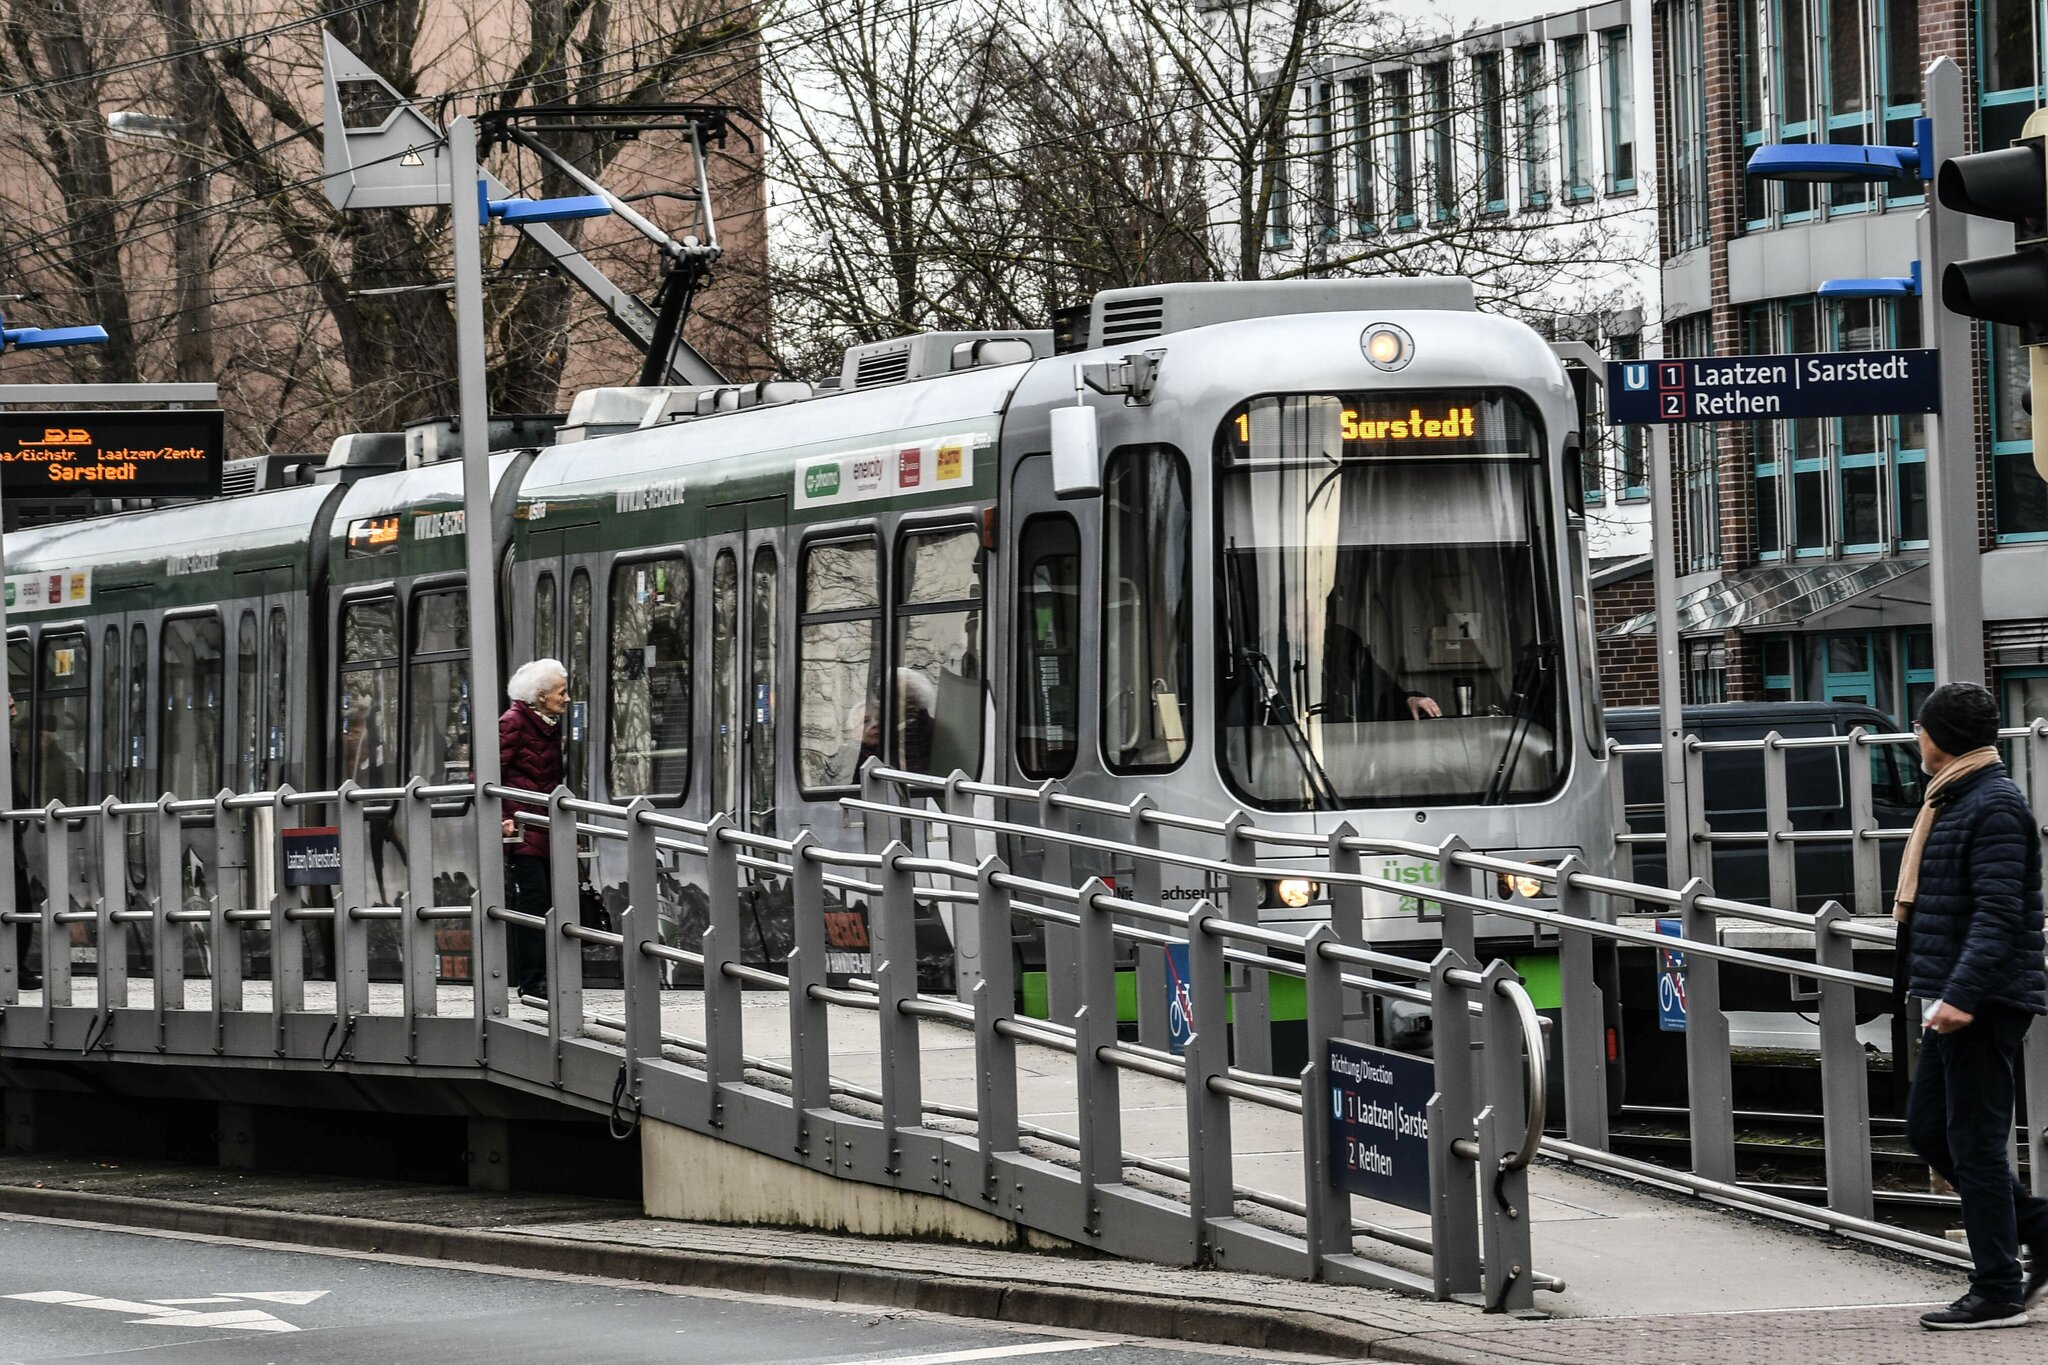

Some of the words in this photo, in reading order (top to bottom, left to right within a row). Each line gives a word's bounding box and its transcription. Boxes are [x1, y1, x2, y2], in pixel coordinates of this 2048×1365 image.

[1627, 366, 1646, 388] U
[1667, 367, 1677, 386] 1
[1694, 364, 1786, 387] Laatzen
[1807, 355, 1909, 383] Sarstedt
[1667, 397, 1679, 415] 2
[1695, 392, 1780, 417] Rethen
[1235, 413, 1249, 442] 1
[1340, 408, 1475, 440] Sarstedt
[97, 447, 206, 460] Laatzen/Zentr.
[48, 462, 138, 480] Sarstedt
[1116, 885, 1209, 901] Nieachsen
[1331, 1053, 1394, 1086] Richtung/Direction
[1333, 1089, 1343, 1118] U
[1348, 1096, 1353, 1118] 1
[1357, 1096, 1394, 1131] Laatzen
[1398, 1106, 1429, 1140] Sarste
[1348, 1142, 1356, 1164] 2
[1358, 1142, 1393, 1177] Rethen
